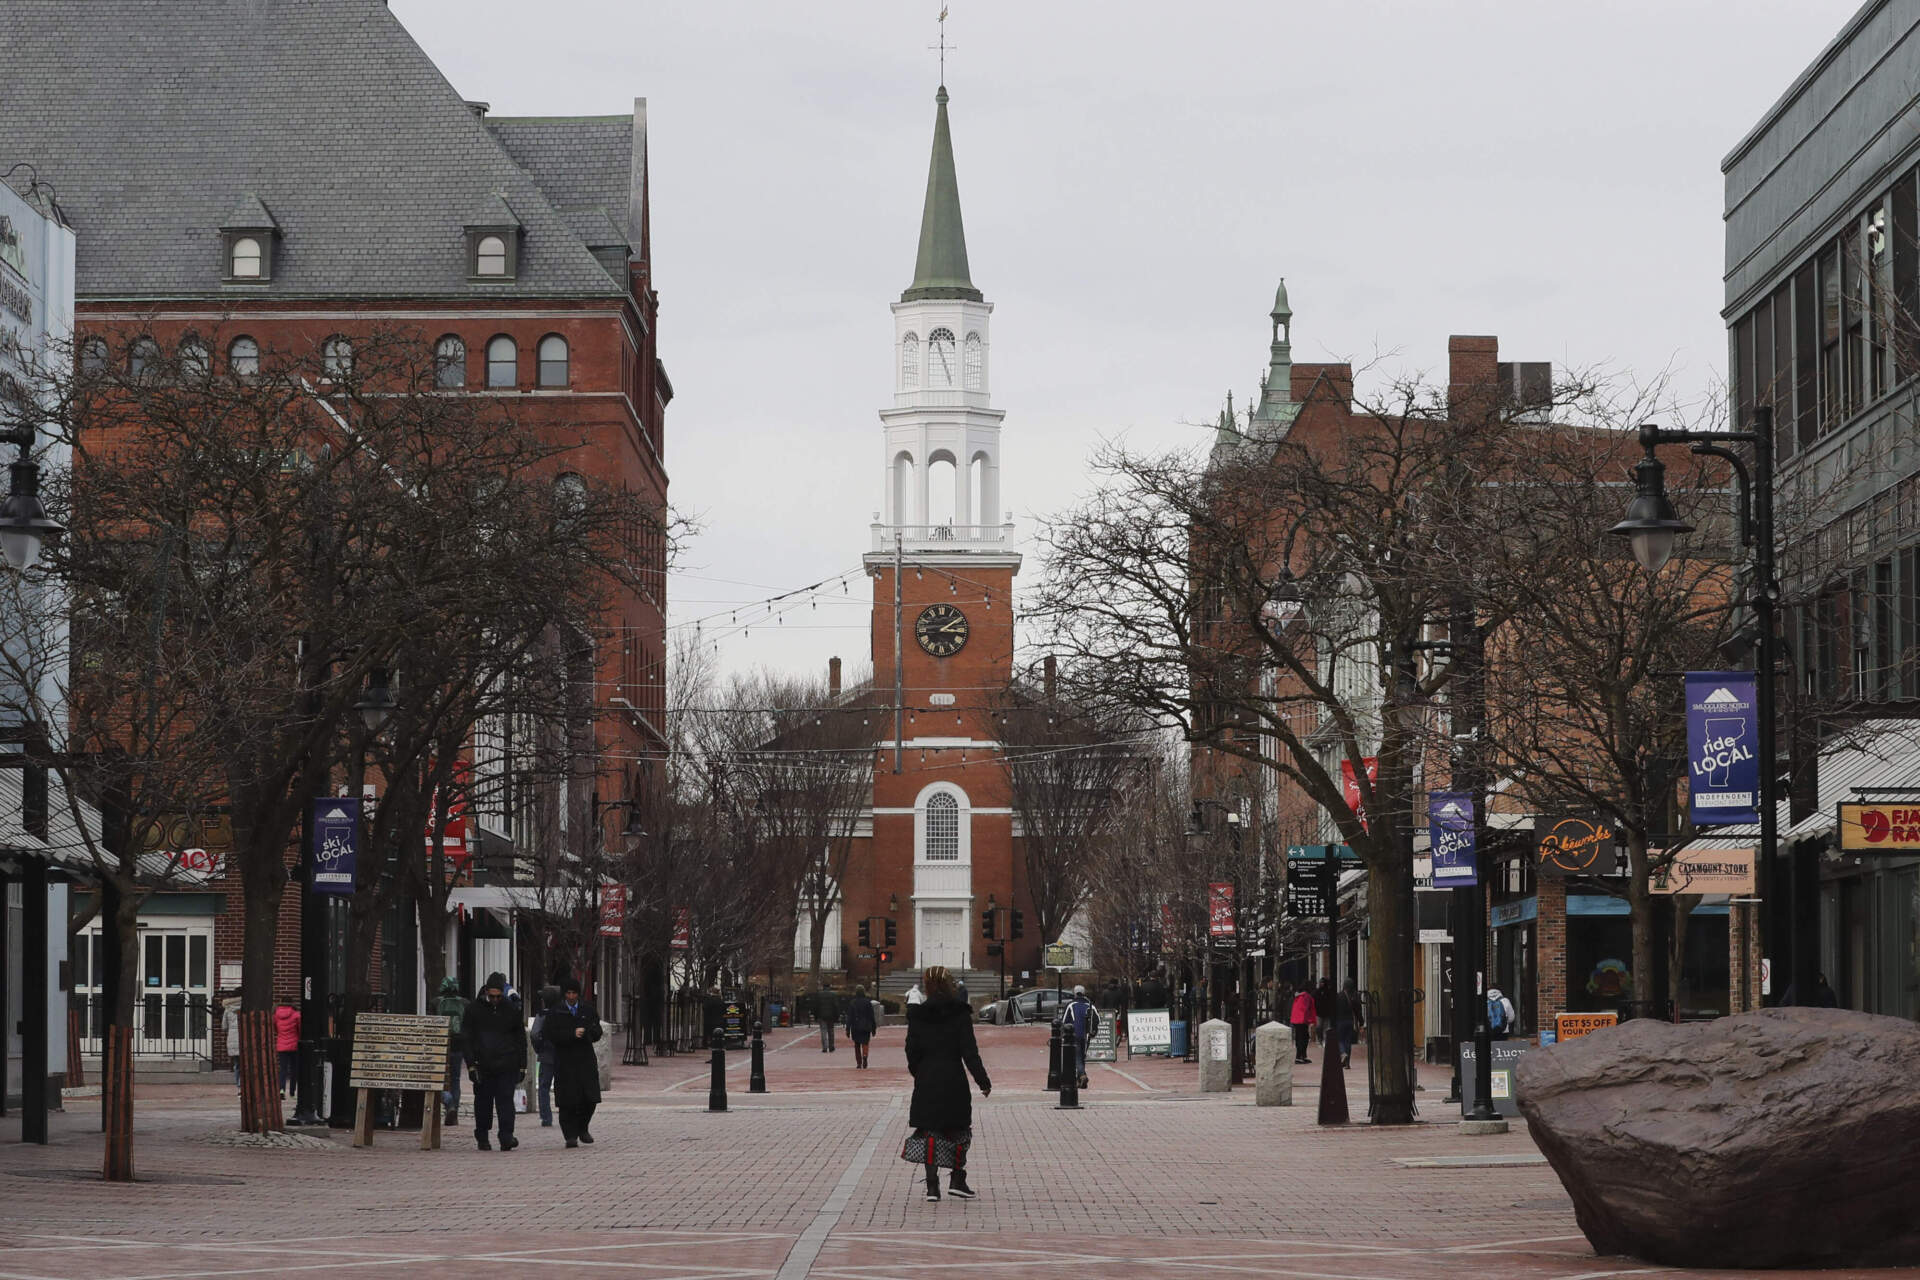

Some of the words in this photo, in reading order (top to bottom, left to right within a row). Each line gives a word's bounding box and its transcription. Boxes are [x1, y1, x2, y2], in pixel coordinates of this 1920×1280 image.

[1703, 736, 1735, 755] ride
[1692, 744, 1753, 776] LOCAL
[1696, 793, 1751, 801] INDEPENDENT
[323, 835, 340, 850] ski
[1433, 839, 1471, 857] LOCAL
[316, 844, 354, 863] LOCAL
[1679, 863, 1722, 873] CATAMOUNT
[1724, 863, 1748, 874] STORE
[1135, 1016, 1163, 1024] SPIRIT
[1562, 1019, 1578, 1028] GET
[1581, 1018, 1591, 1028] $5
[1593, 1018, 1612, 1028] OFF
[1132, 1025, 1168, 1033] TASTING
